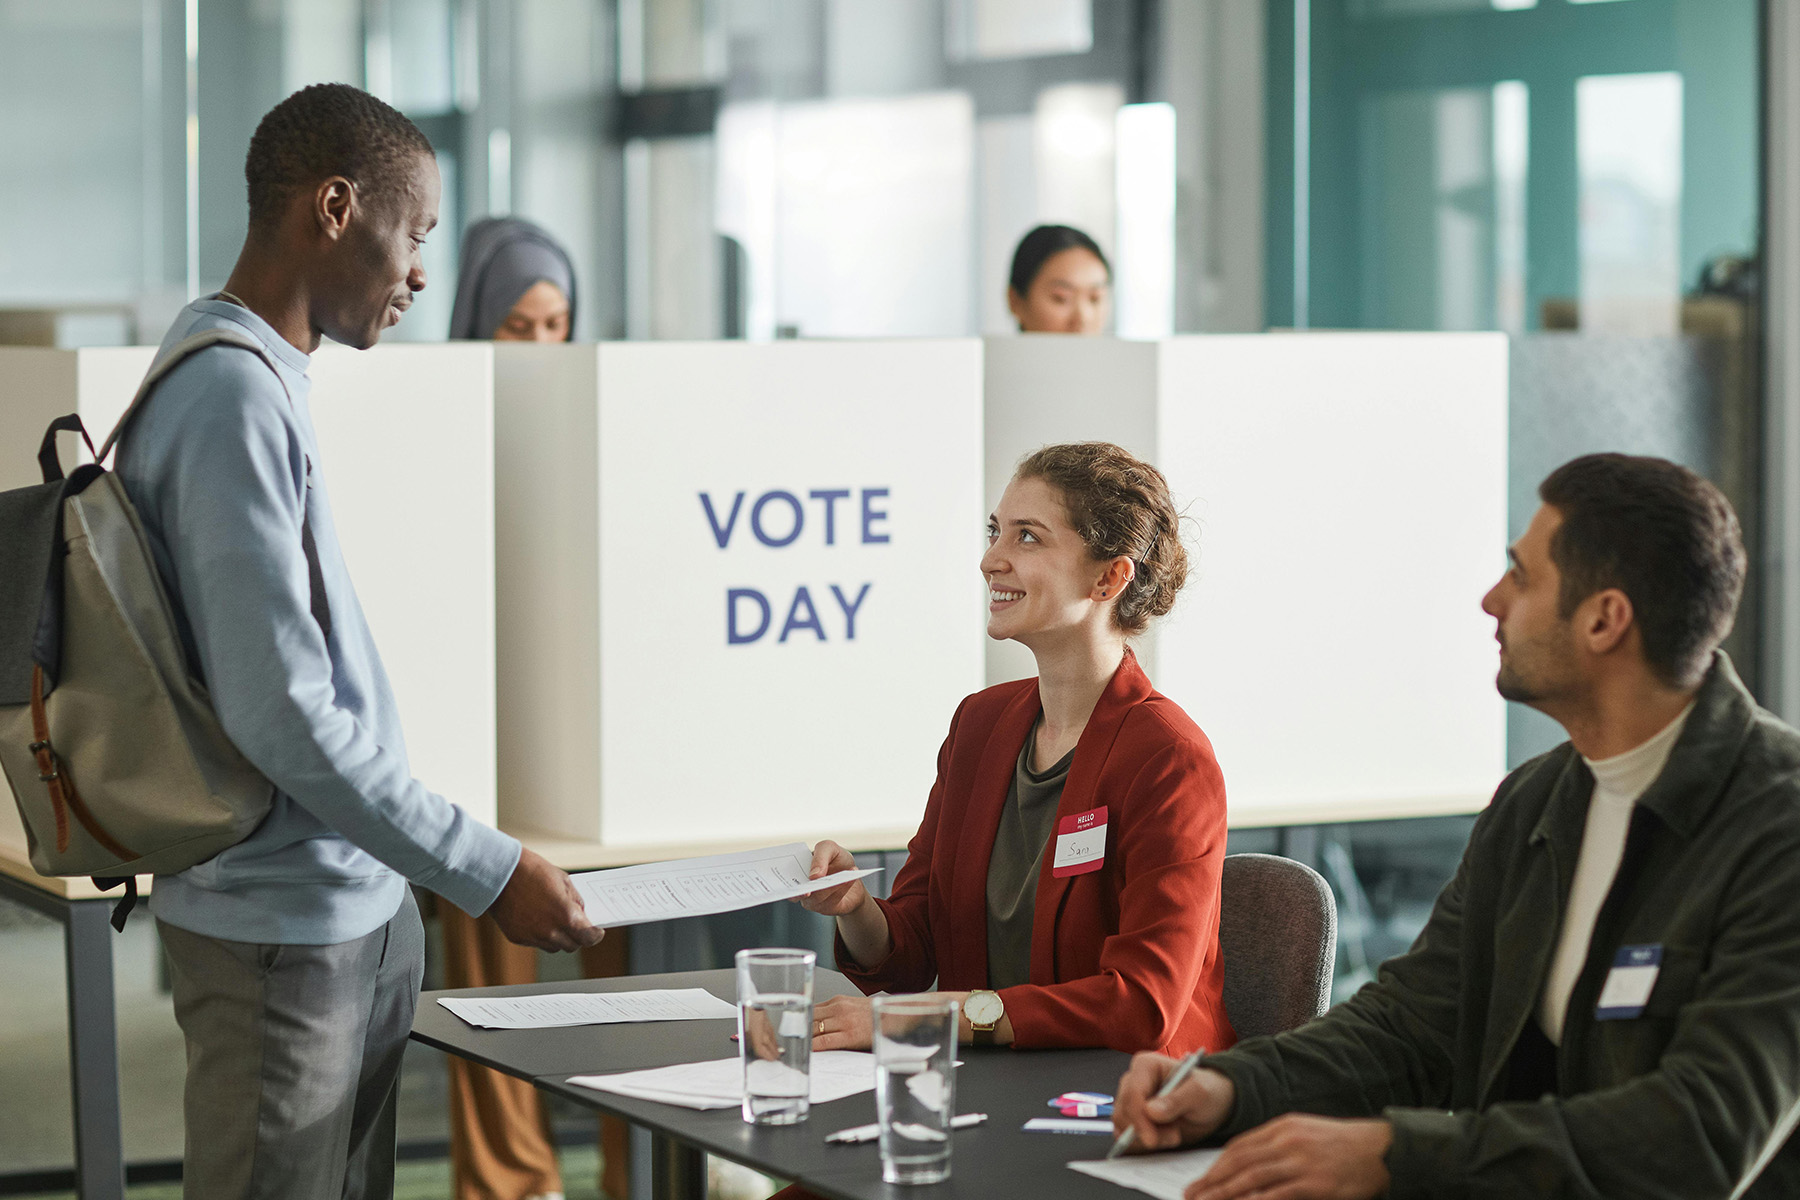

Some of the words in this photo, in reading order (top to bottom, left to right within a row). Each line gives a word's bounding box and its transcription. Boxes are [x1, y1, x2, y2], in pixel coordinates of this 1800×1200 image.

[699, 488, 891, 549] VOTE
[727, 583, 871, 645] DAY
[1077, 813, 1095, 824] HELLO
